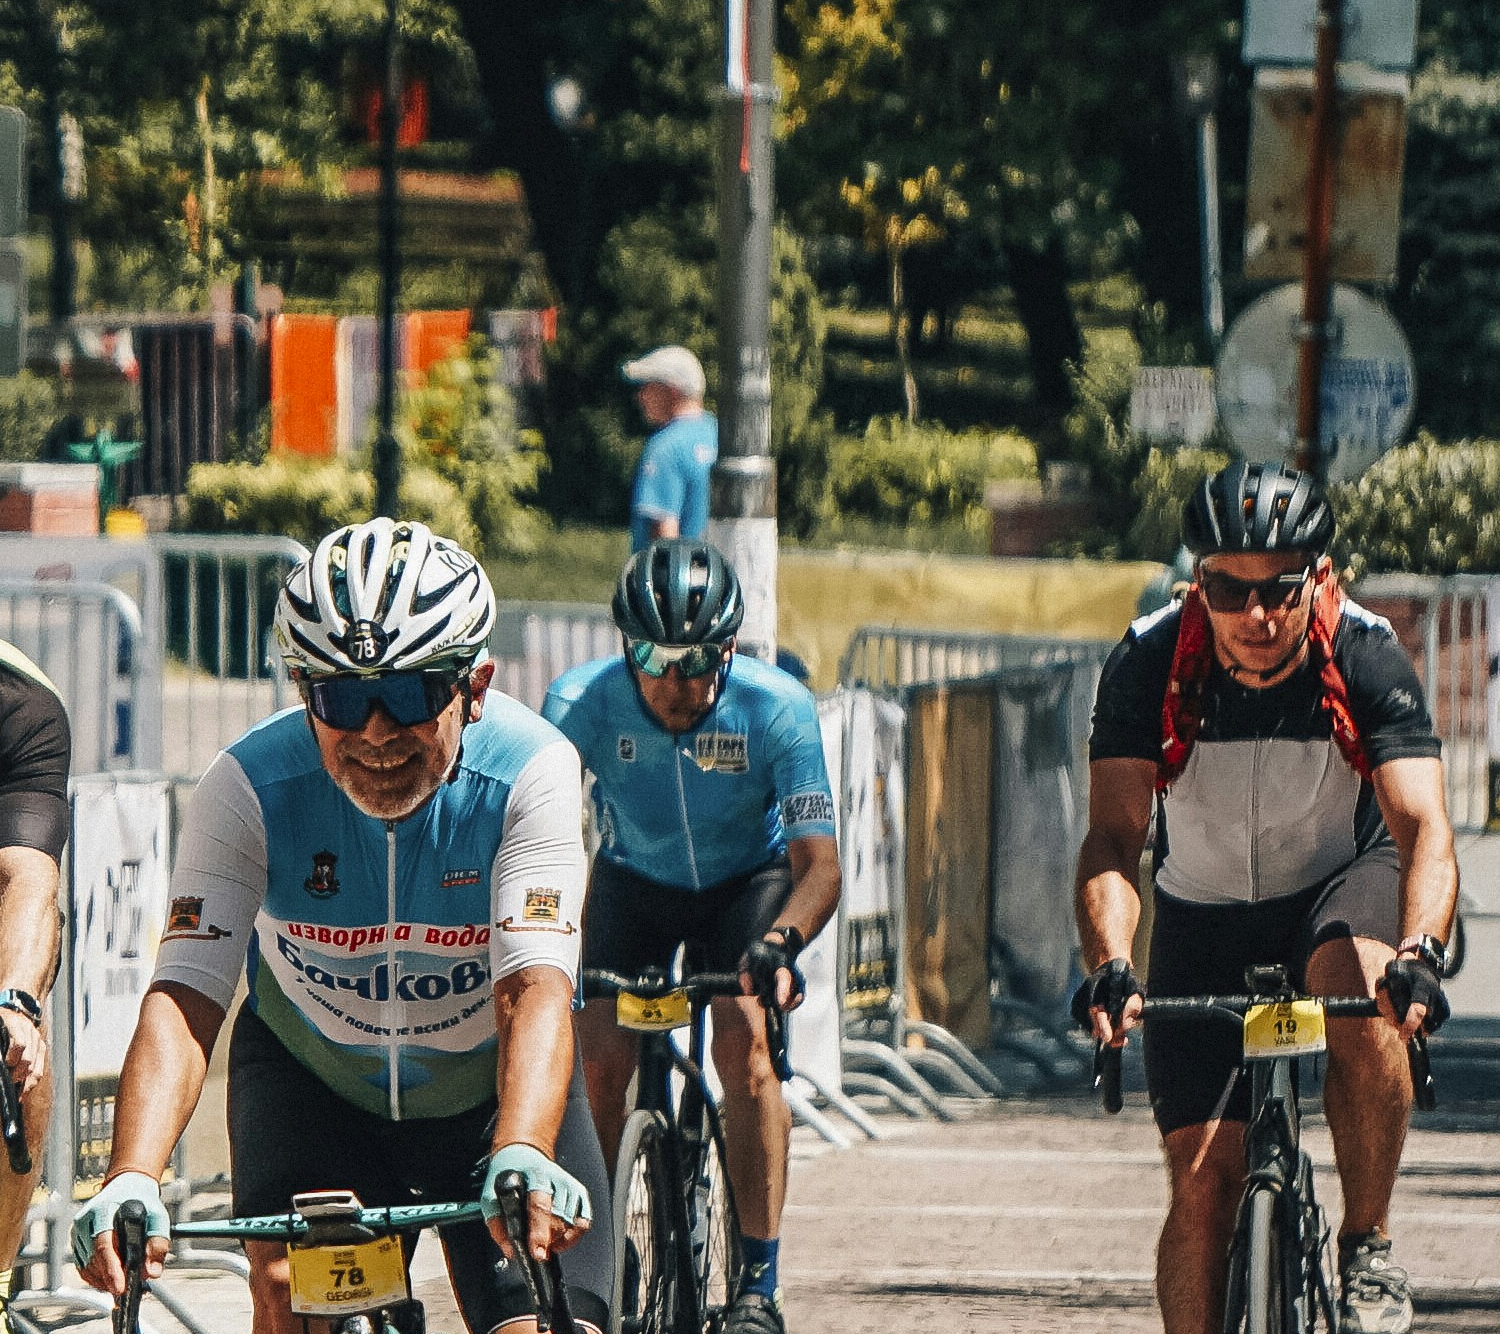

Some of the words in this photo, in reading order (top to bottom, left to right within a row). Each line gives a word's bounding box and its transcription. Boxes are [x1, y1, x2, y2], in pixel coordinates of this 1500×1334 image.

[354, 637, 375, 659] 78
[424, 922, 491, 948] вода
[275, 930, 492, 1002] Бачков
[1274, 1020, 1297, 1034] 19
[329, 1267, 365, 1287] 78
